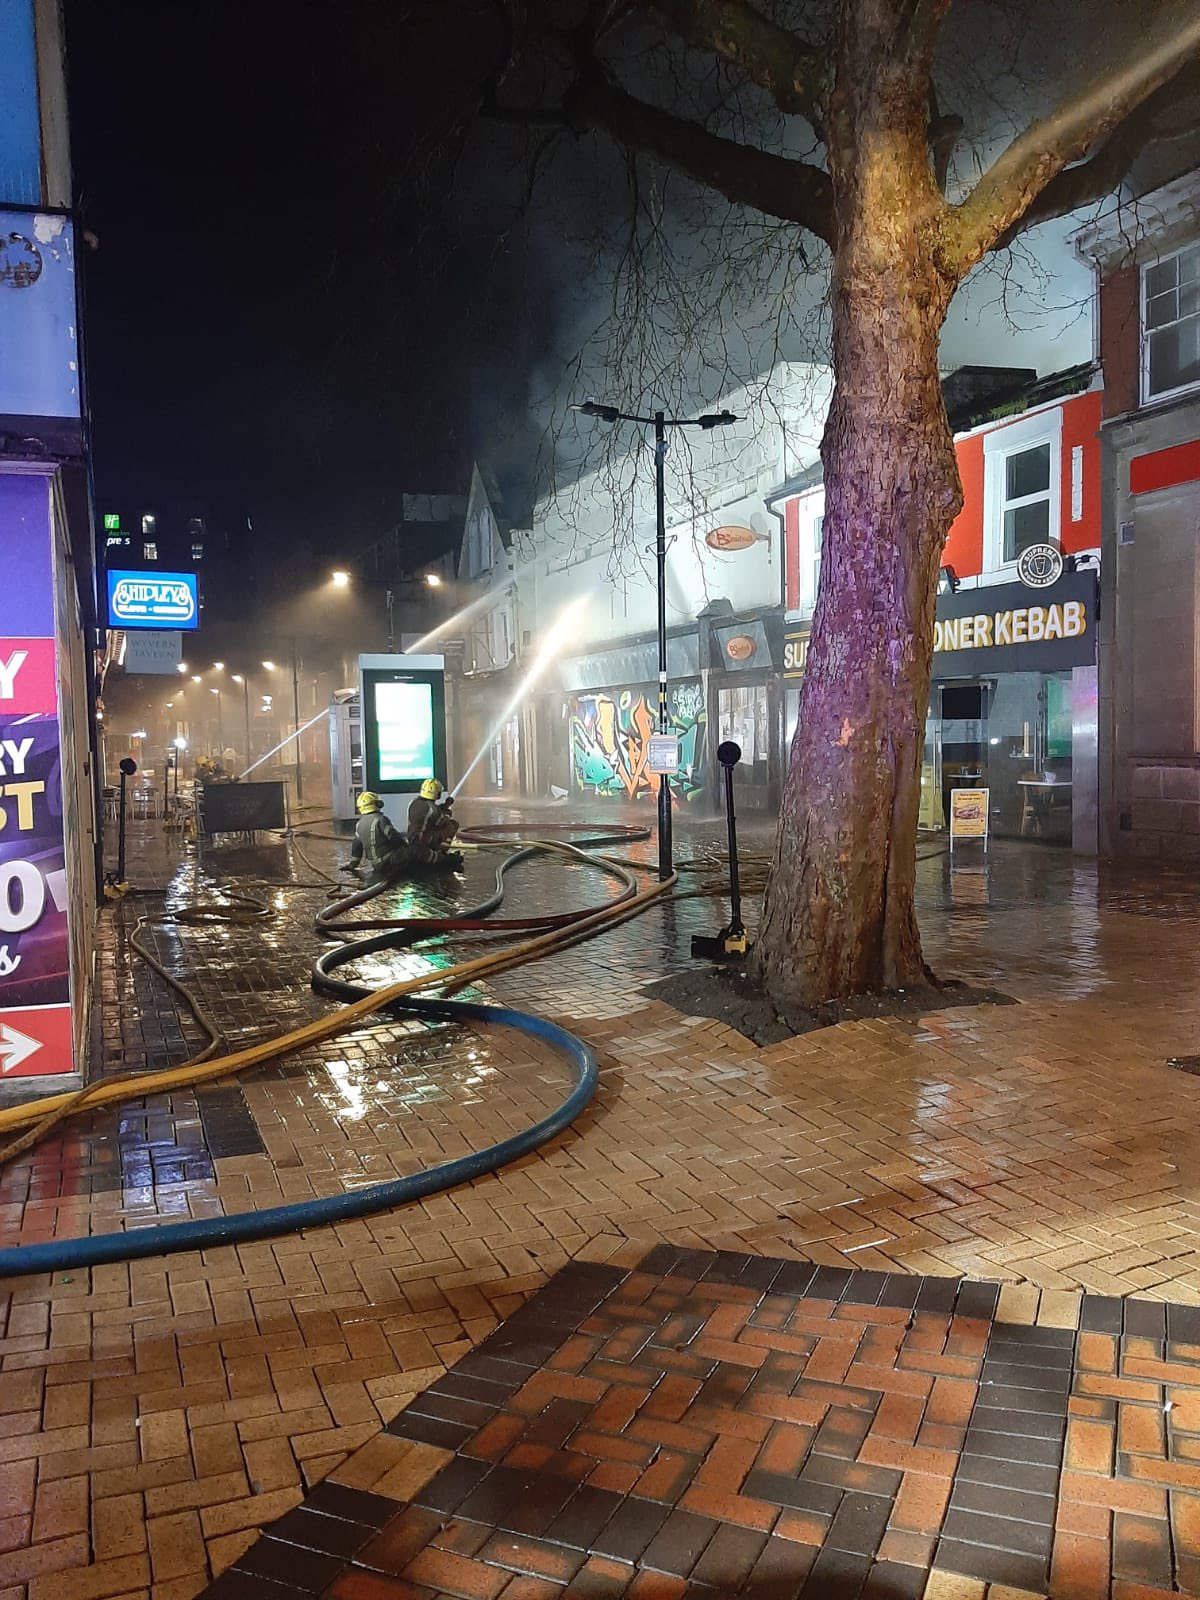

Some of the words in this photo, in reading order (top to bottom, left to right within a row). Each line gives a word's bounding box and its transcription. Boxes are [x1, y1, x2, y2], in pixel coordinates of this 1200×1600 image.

[117, 583, 189, 606] SHIPLEYS
[994, 600, 1087, 646] KEBAB
[130, 639, 177, 649] WYVERN
[133, 649, 175, 660] TAVERN
